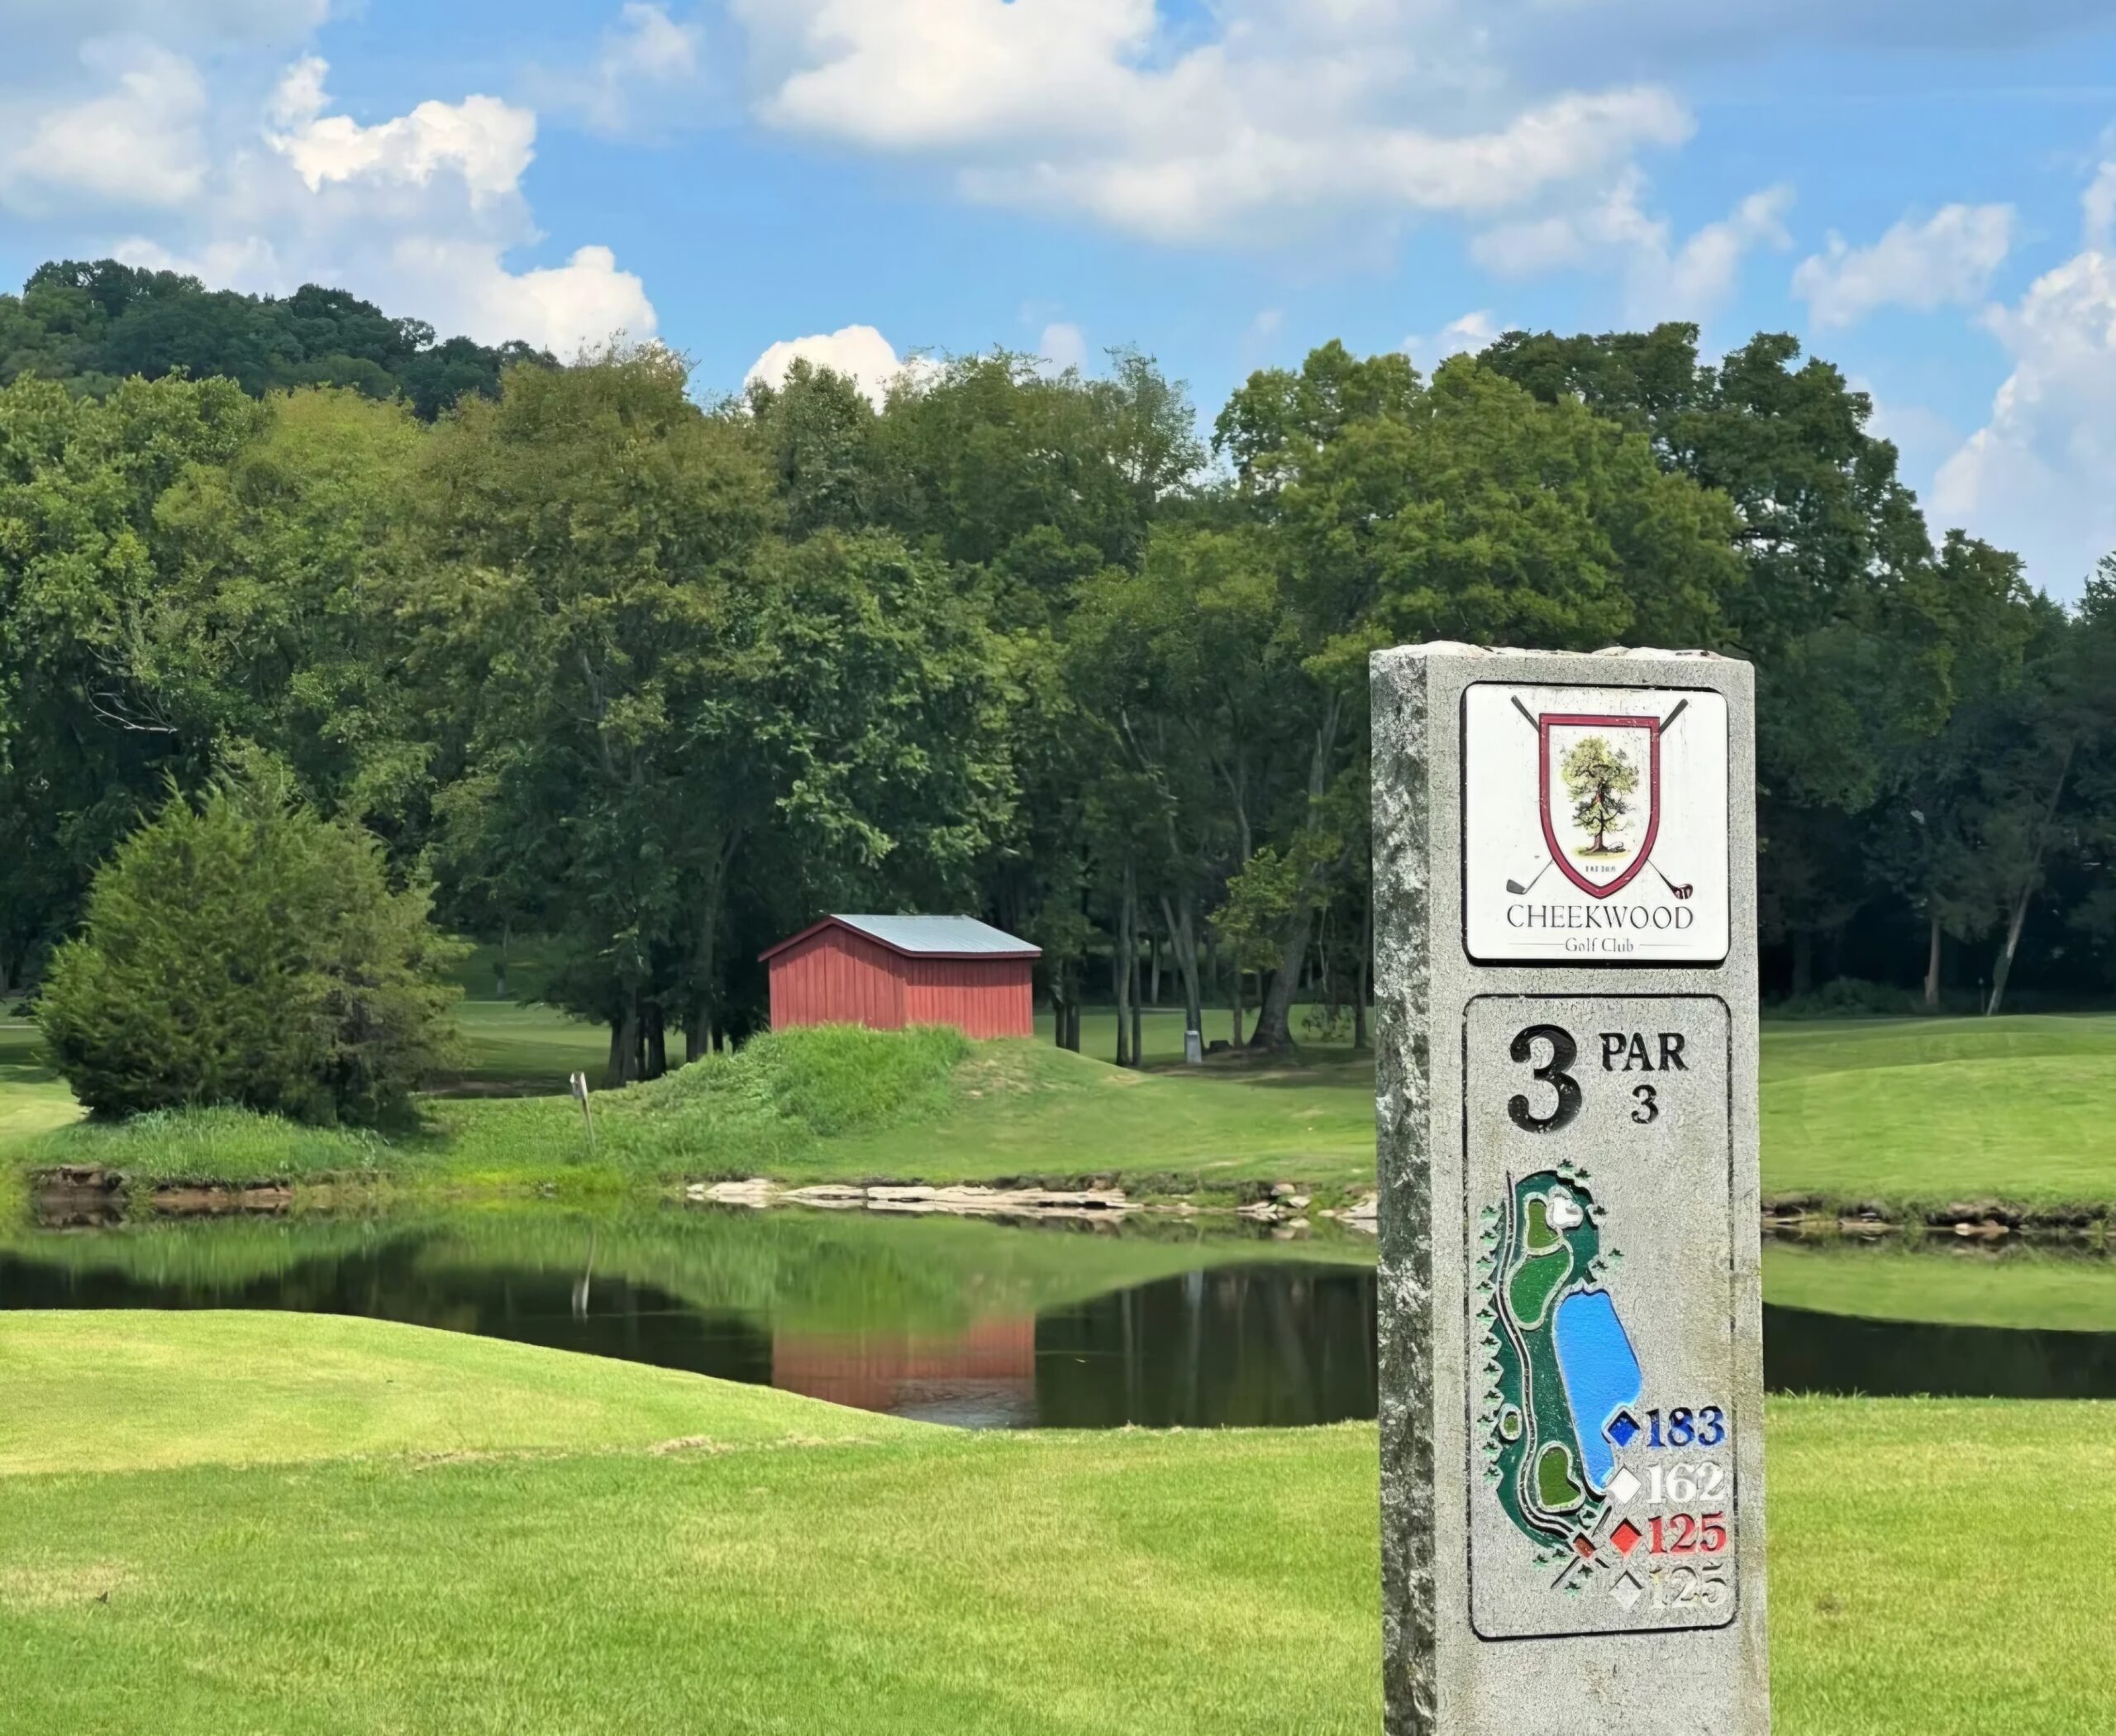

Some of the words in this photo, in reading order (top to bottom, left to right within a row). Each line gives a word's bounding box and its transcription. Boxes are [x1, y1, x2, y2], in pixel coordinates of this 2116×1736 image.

[1507, 904, 1694, 929] CHEEKWOOD
[1565, 937, 1597, 952] Golf
[1601, 937, 1634, 952] Club
[1507, 1023, 1582, 1133] 3
[1599, 1033, 1689, 1071] PAR
[1631, 1084, 1658, 1124] 3
[1645, 1405, 1727, 1447] 183
[1646, 1461, 1724, 1504] 162
[1647, 1511, 1728, 1555] 125
[1648, 1563, 1728, 1610] 125
